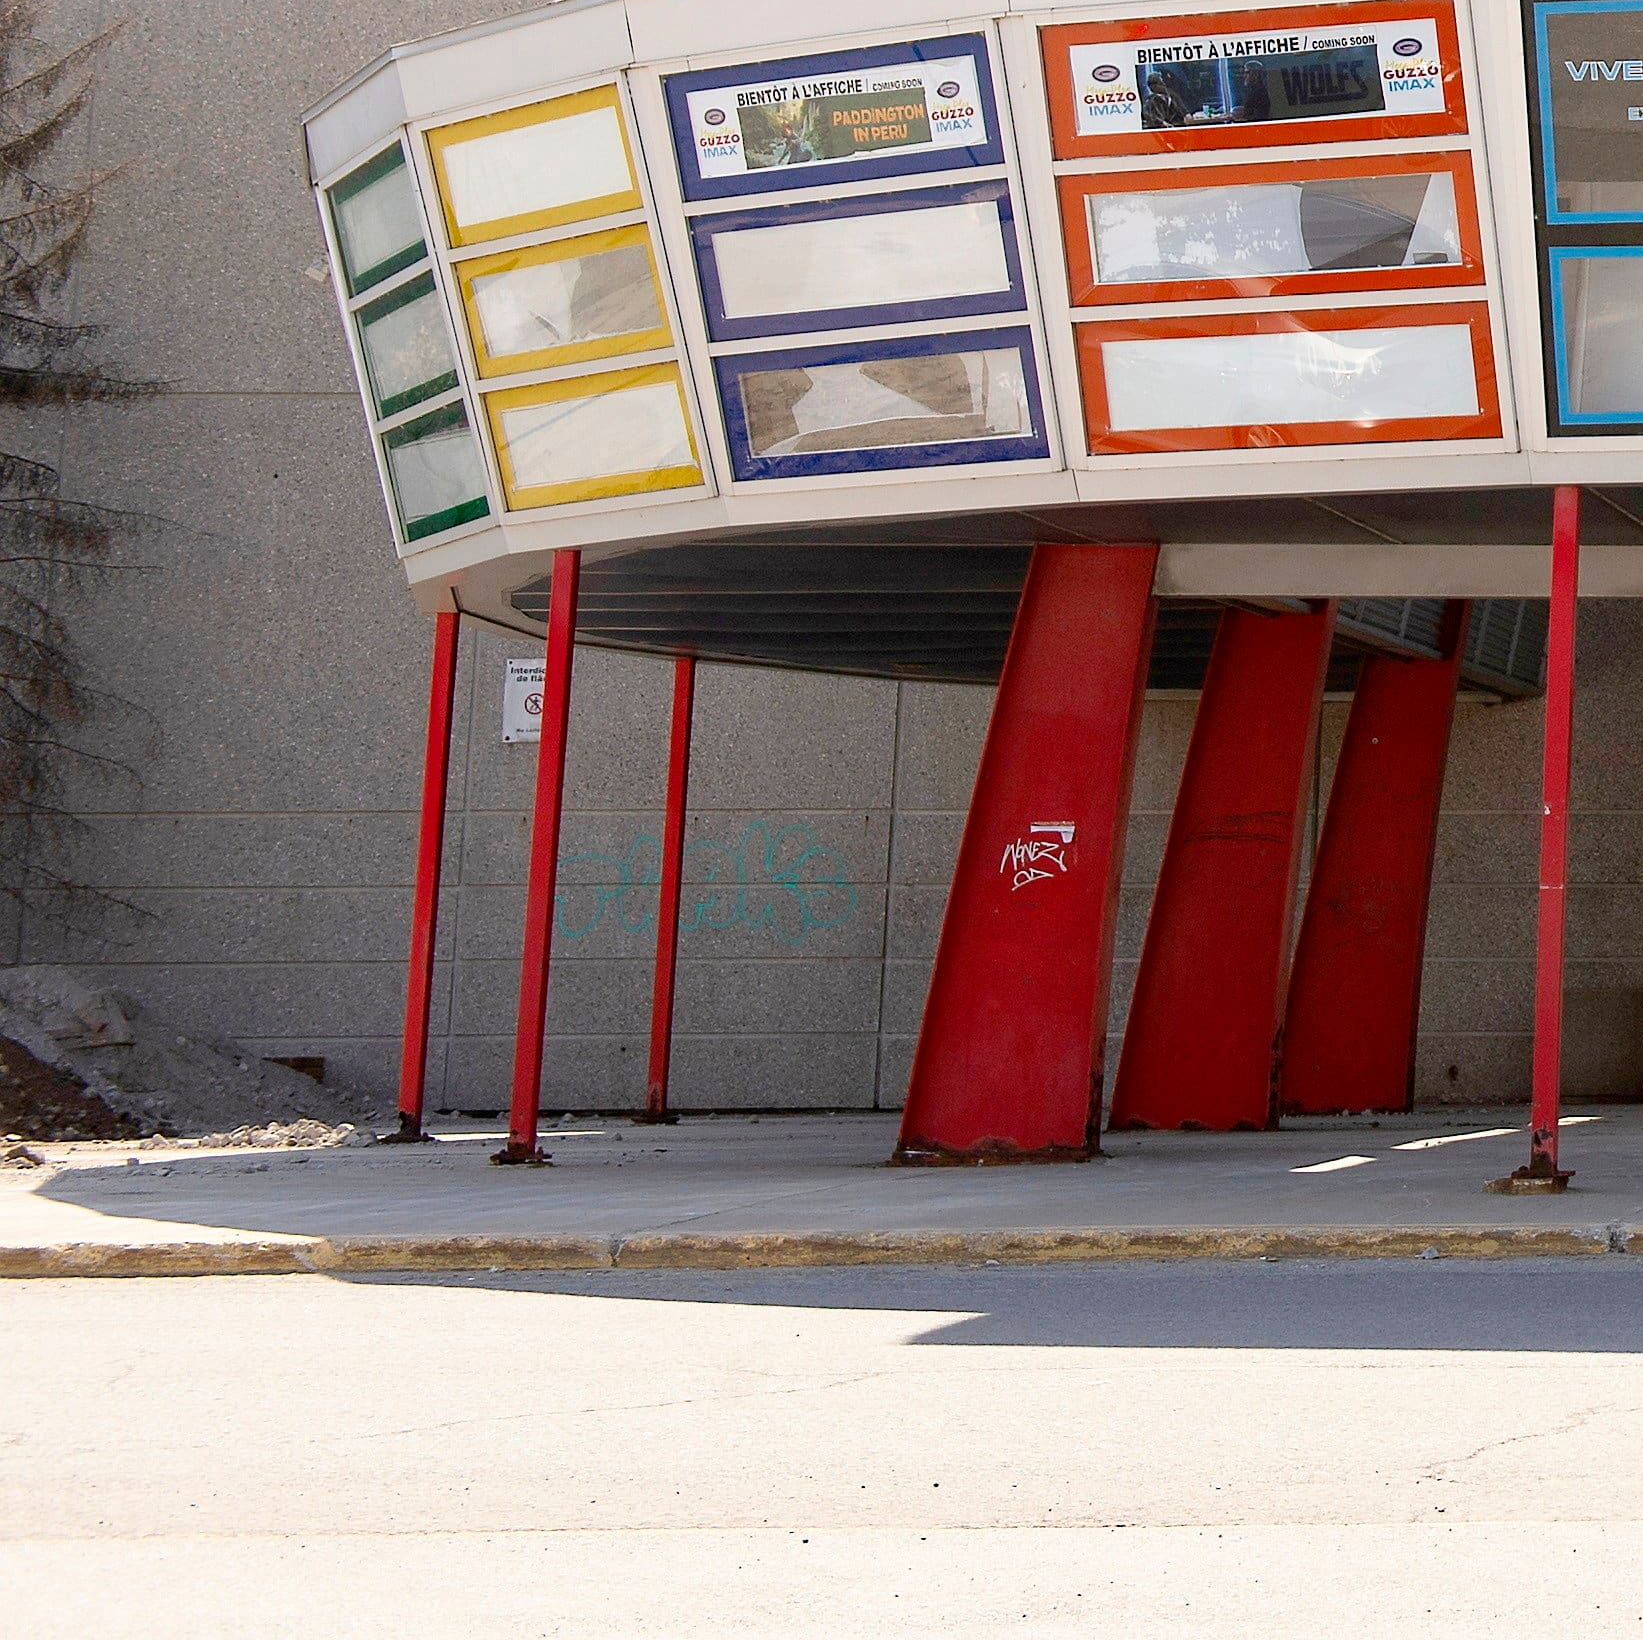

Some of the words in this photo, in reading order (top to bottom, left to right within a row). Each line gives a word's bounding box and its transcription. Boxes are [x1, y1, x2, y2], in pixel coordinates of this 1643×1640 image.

[1137, 42, 1203, 64] BIENTÔT
[1208, 40, 1219, 59] À
[1222, 36, 1300, 58] L'AFFICHE
[1312, 37, 1348, 50] COMING
[1350, 34, 1376, 46] SOON
[1388, 77, 1436, 92] IMAX
[736, 85, 788, 107] BIENTÔT
[1084, 91, 1137, 105] GUZZO
[832, 104, 925, 126] PADDINGTON
[931, 106, 974, 121] GUZZO
[1089, 103, 1133, 117] IMAX
[853, 127, 870, 142] IN
[871, 124, 908, 140] PERU
[936, 118, 972, 133] IMAX
[699, 133, 741, 148] GUZZO
[703, 145, 738, 158] IMAX
